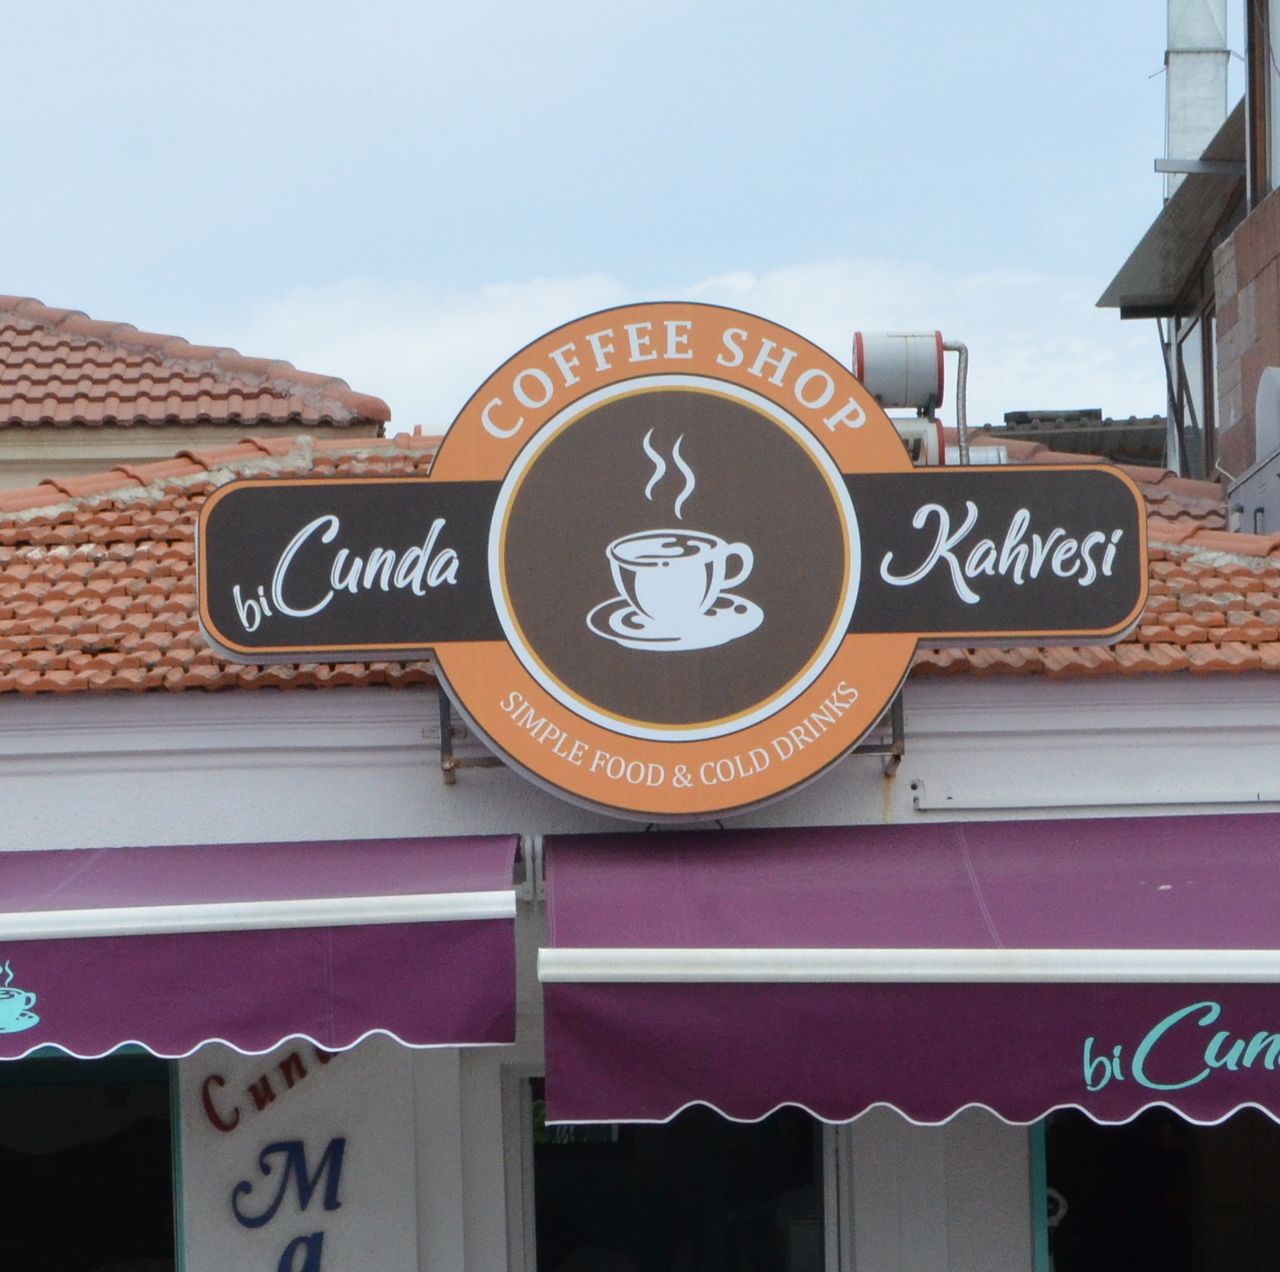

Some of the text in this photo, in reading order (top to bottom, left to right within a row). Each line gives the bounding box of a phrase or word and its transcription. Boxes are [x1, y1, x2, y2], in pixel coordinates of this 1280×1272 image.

[480, 319, 867, 440] COFFEE SHOP
[232, 514, 460, 632] bi Cunda
[880, 501, 1123, 604] Kahvesi
[500, 680, 859, 788] SIMPLE FOOD & COLD DRINKS
[202, 1047, 339, 1133] Cun
[1083, 1036, 1124, 1092] bi
